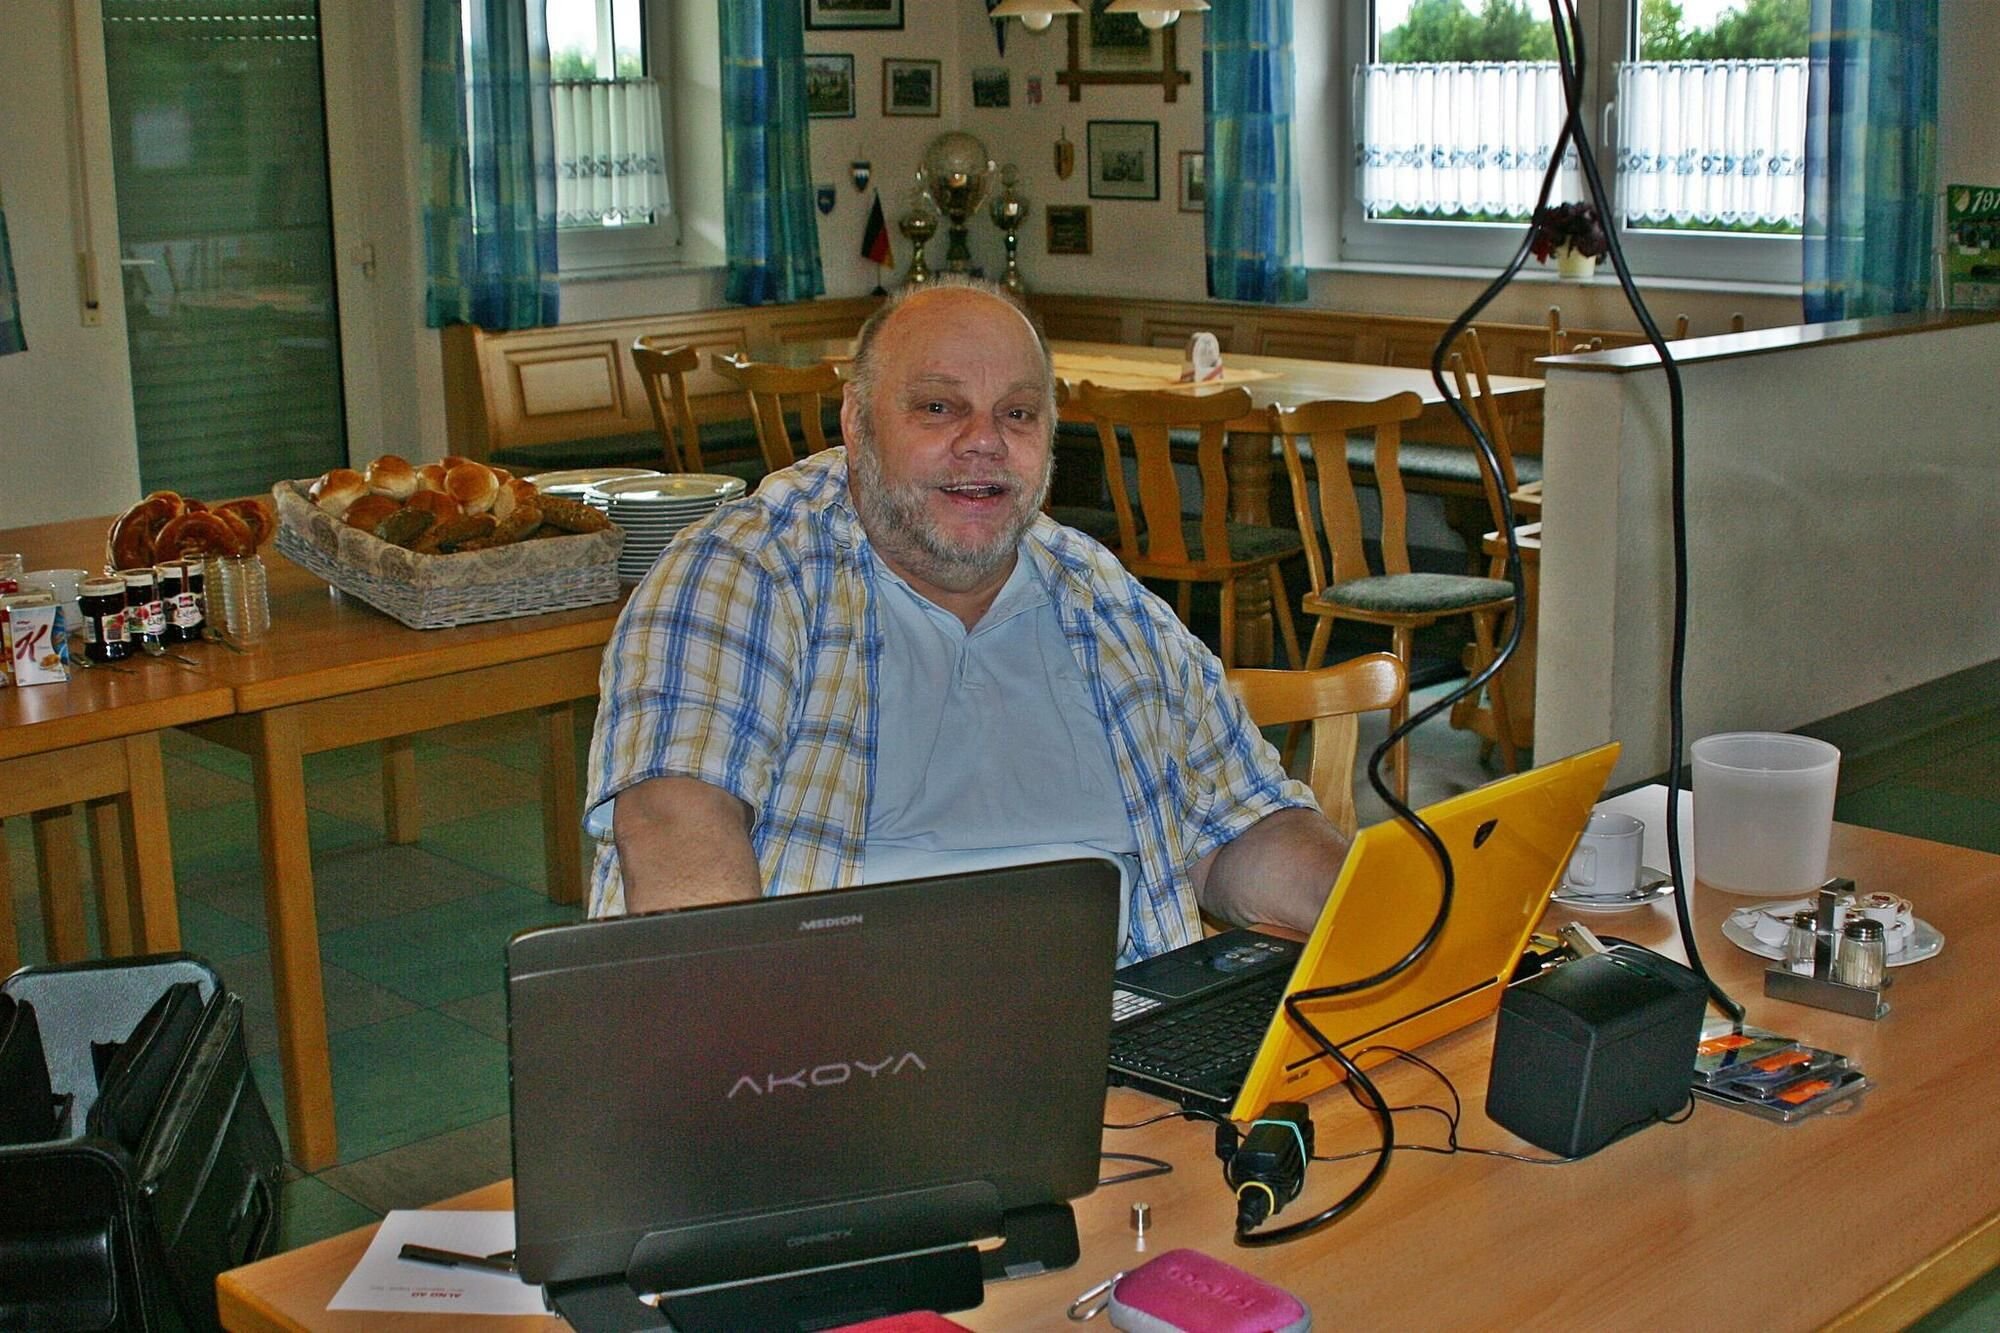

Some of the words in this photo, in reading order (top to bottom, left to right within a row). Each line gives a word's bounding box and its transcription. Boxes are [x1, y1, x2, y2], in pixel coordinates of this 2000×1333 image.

[15, 624, 49, 662] K
[799, 914, 863, 931] MEDION
[728, 1052, 926, 1098] AKOYA
